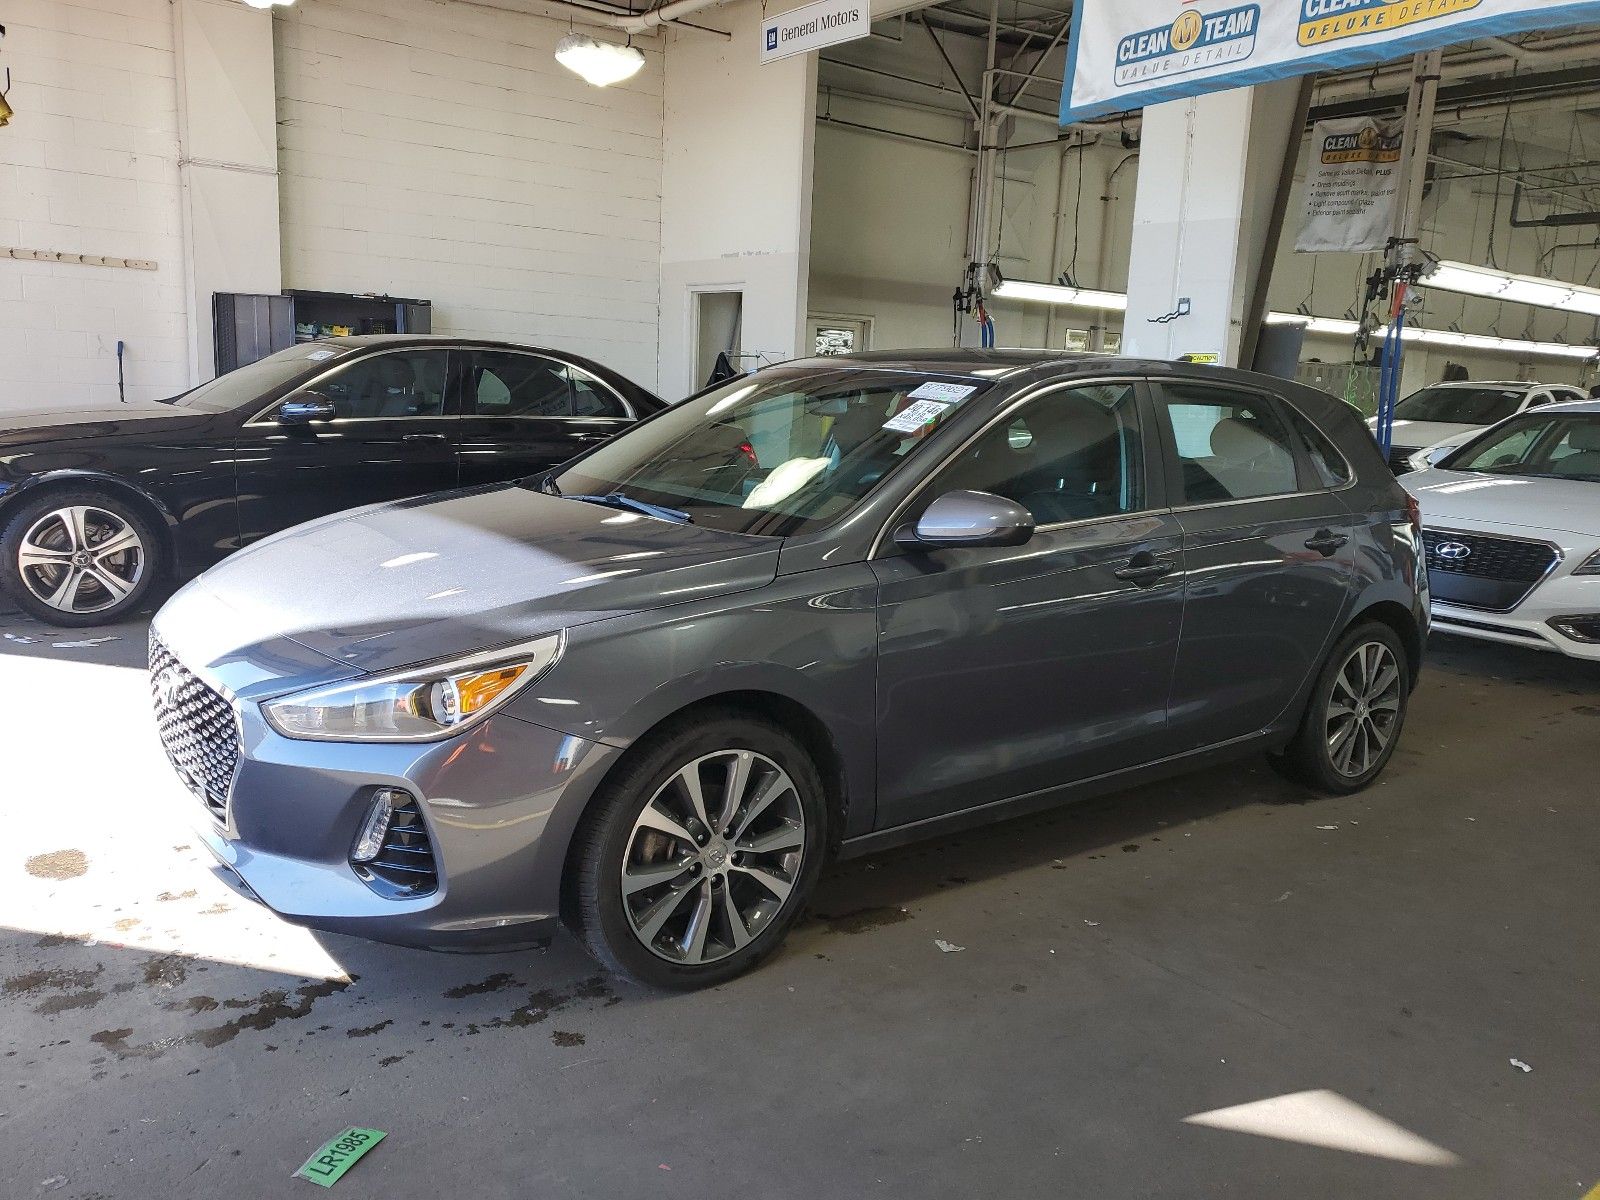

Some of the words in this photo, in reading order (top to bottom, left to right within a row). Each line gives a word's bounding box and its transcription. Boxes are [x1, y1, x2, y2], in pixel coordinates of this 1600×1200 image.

[781, 16, 818, 42] General
[820, 8, 859, 31] Motors
[1306, 0, 1370, 17] CLE
[1307, 12, 1386, 39] DELUXE
[1399, 0, 1469, 20] DETA
[1119, 29, 1170, 61] CLEAN
[1204, 9, 1256, 41] TEAM
[1121, 59, 1170, 80] VALUE
[1182, 43, 1243, 67] DETAIL
[1325, 136, 1358, 150] CLEAN
[1376, 168, 1392, 176] PLUS
[310, 1131, 370, 1176] LR1985
